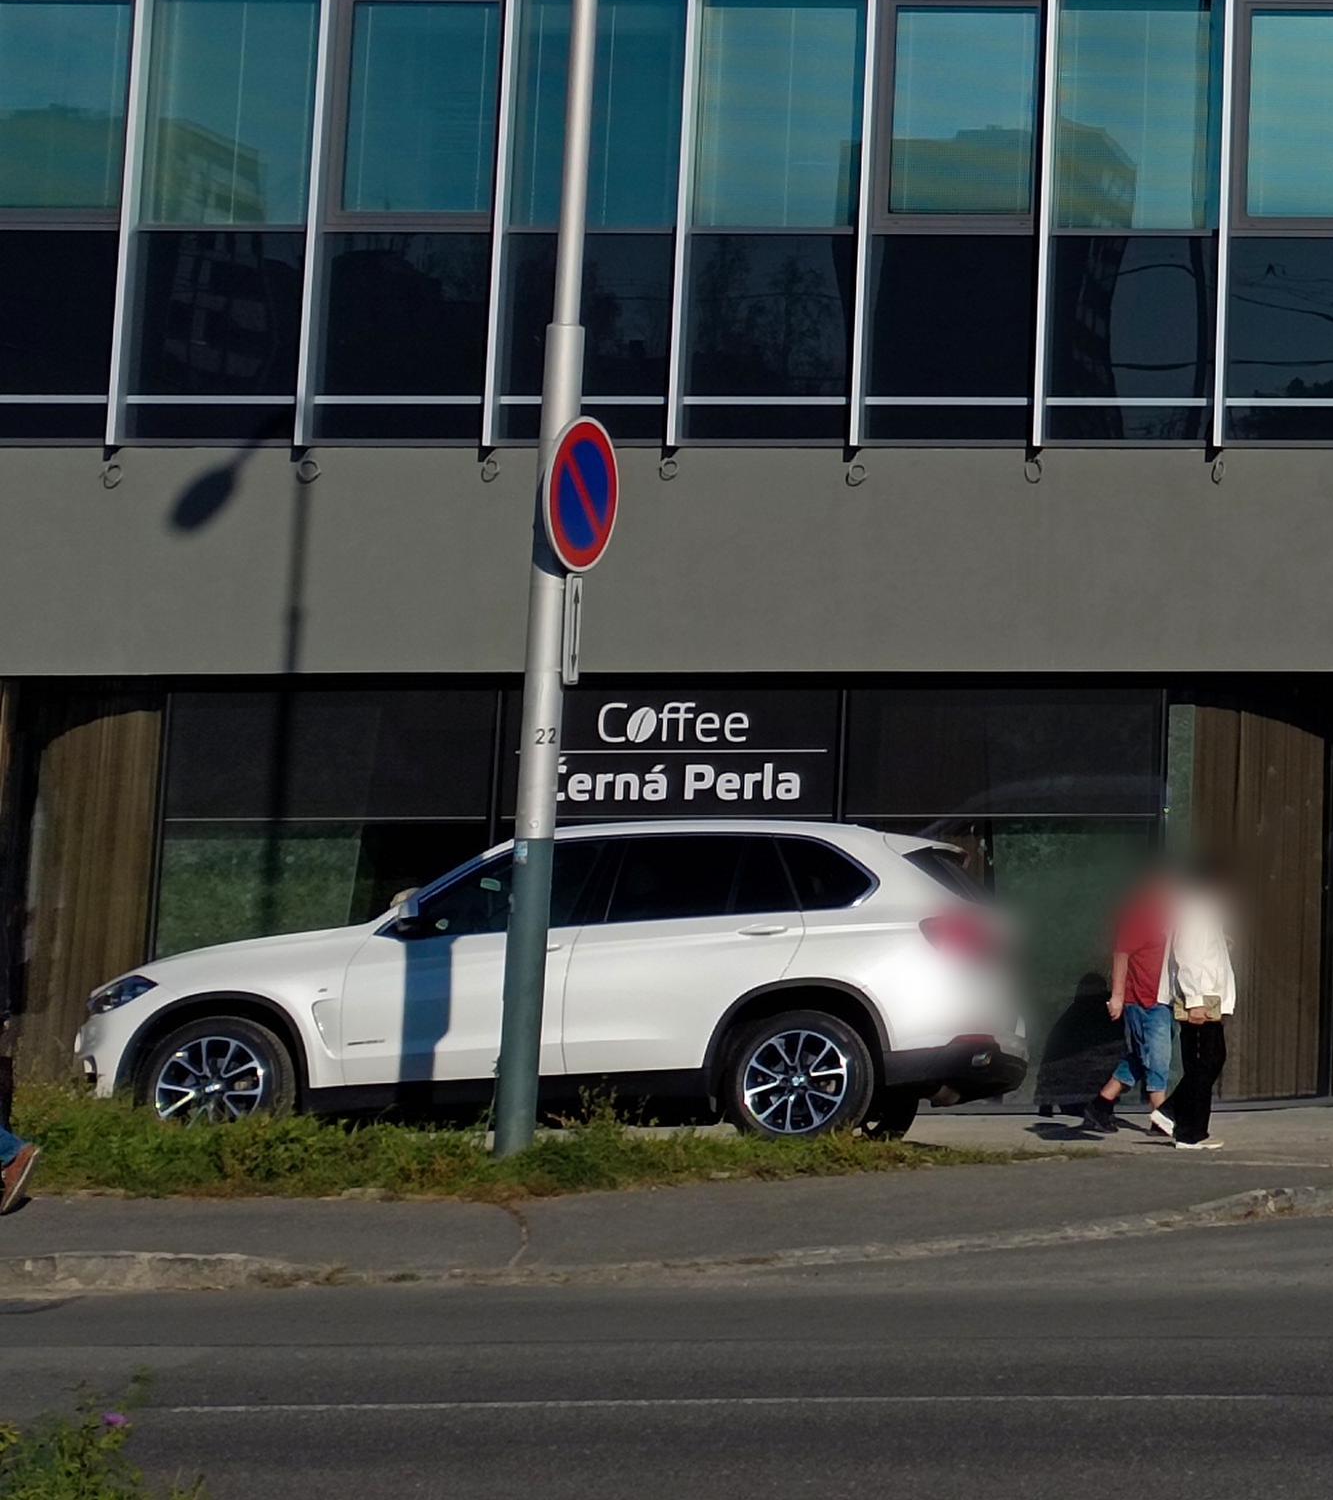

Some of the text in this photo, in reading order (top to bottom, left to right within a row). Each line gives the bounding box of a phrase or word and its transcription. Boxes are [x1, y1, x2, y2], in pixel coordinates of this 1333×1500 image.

[535, 727, 556, 745] 22
[598, 702, 750, 743] Coffee
[684, 763, 801, 800] Perla
